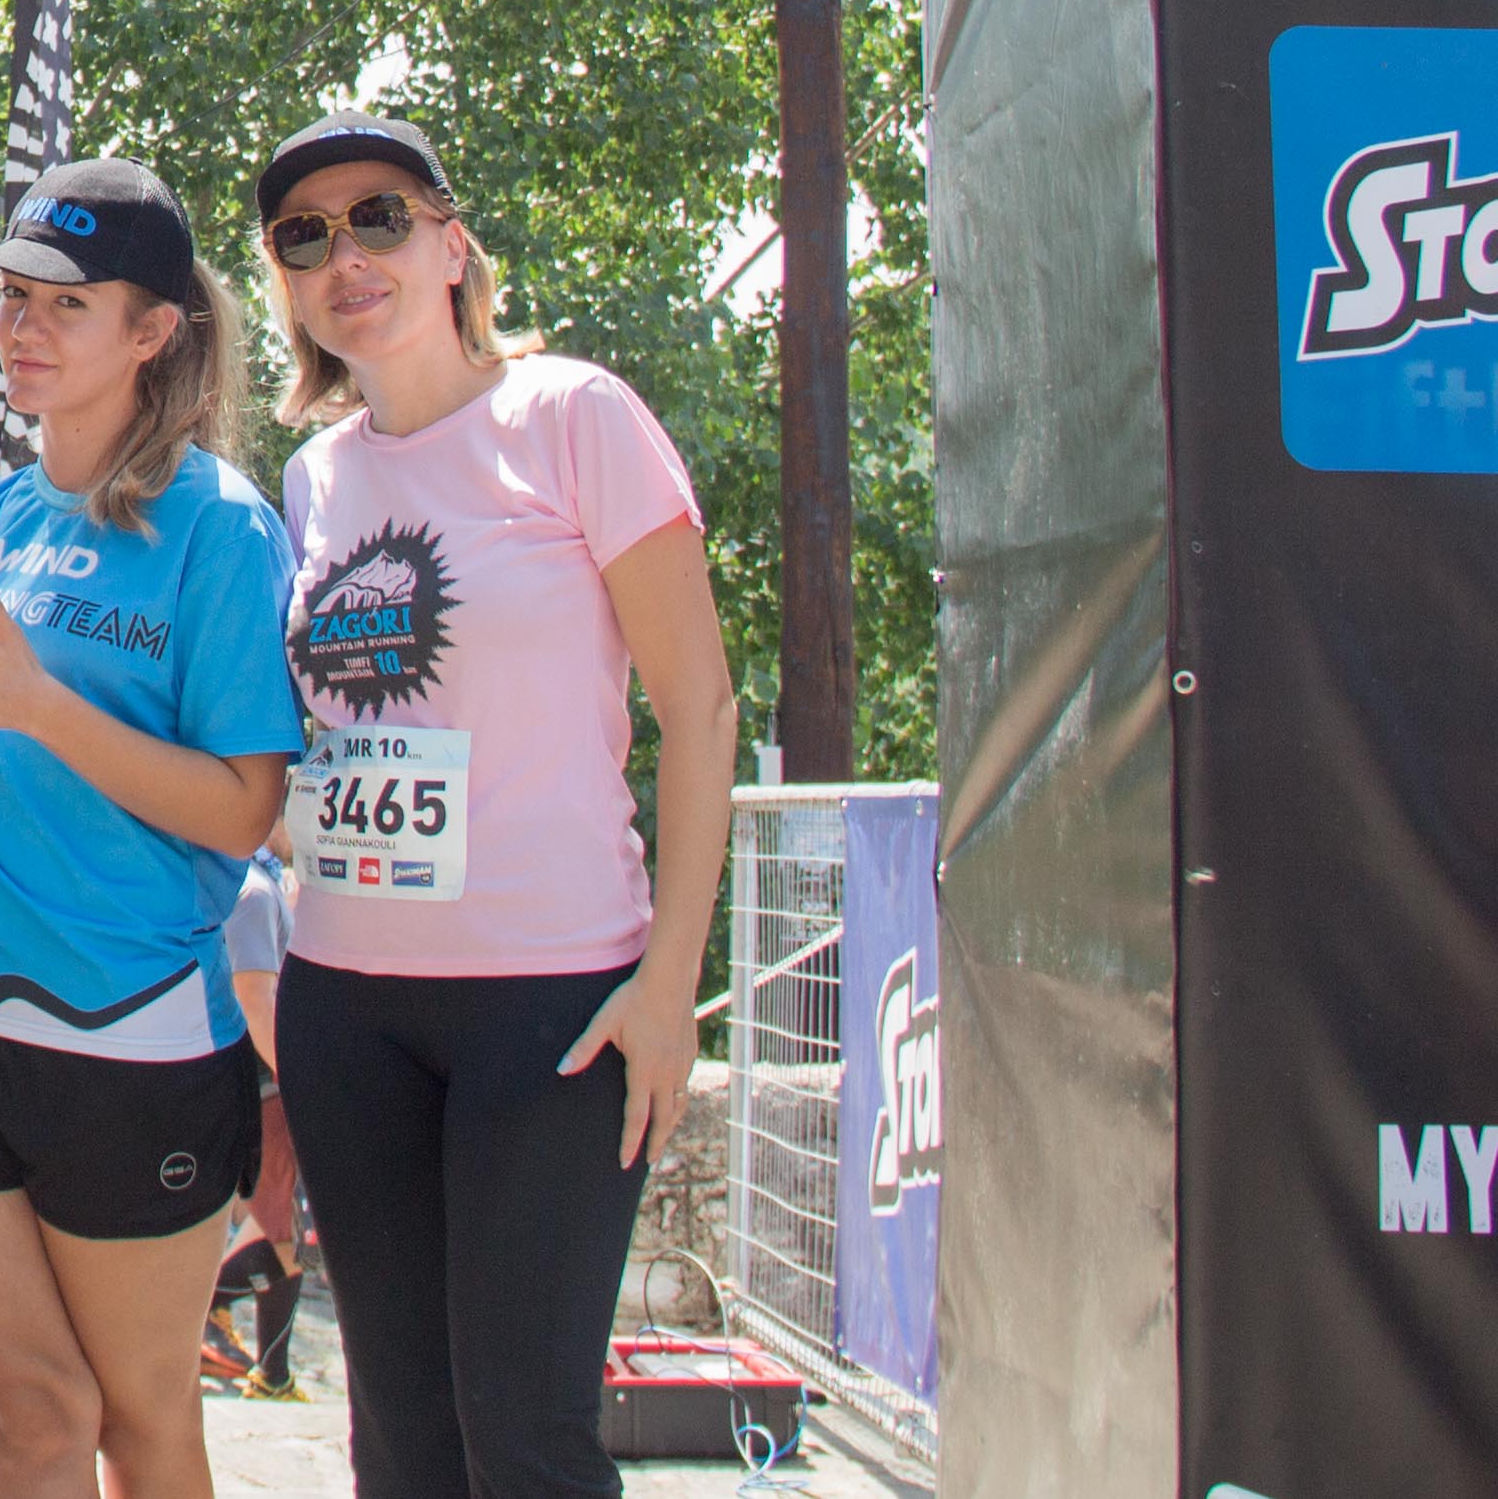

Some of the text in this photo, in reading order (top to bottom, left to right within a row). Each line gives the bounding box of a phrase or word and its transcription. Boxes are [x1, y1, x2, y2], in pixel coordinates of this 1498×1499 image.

[16, 196, 98, 238] WIND
[308, 605, 413, 644] ZAGORI
[309, 634, 416, 655] MOUNTAIN RUNNING
[373, 649, 402, 676] 10
[377, 736, 408, 759] 10
[317, 776, 447, 837] 3465
